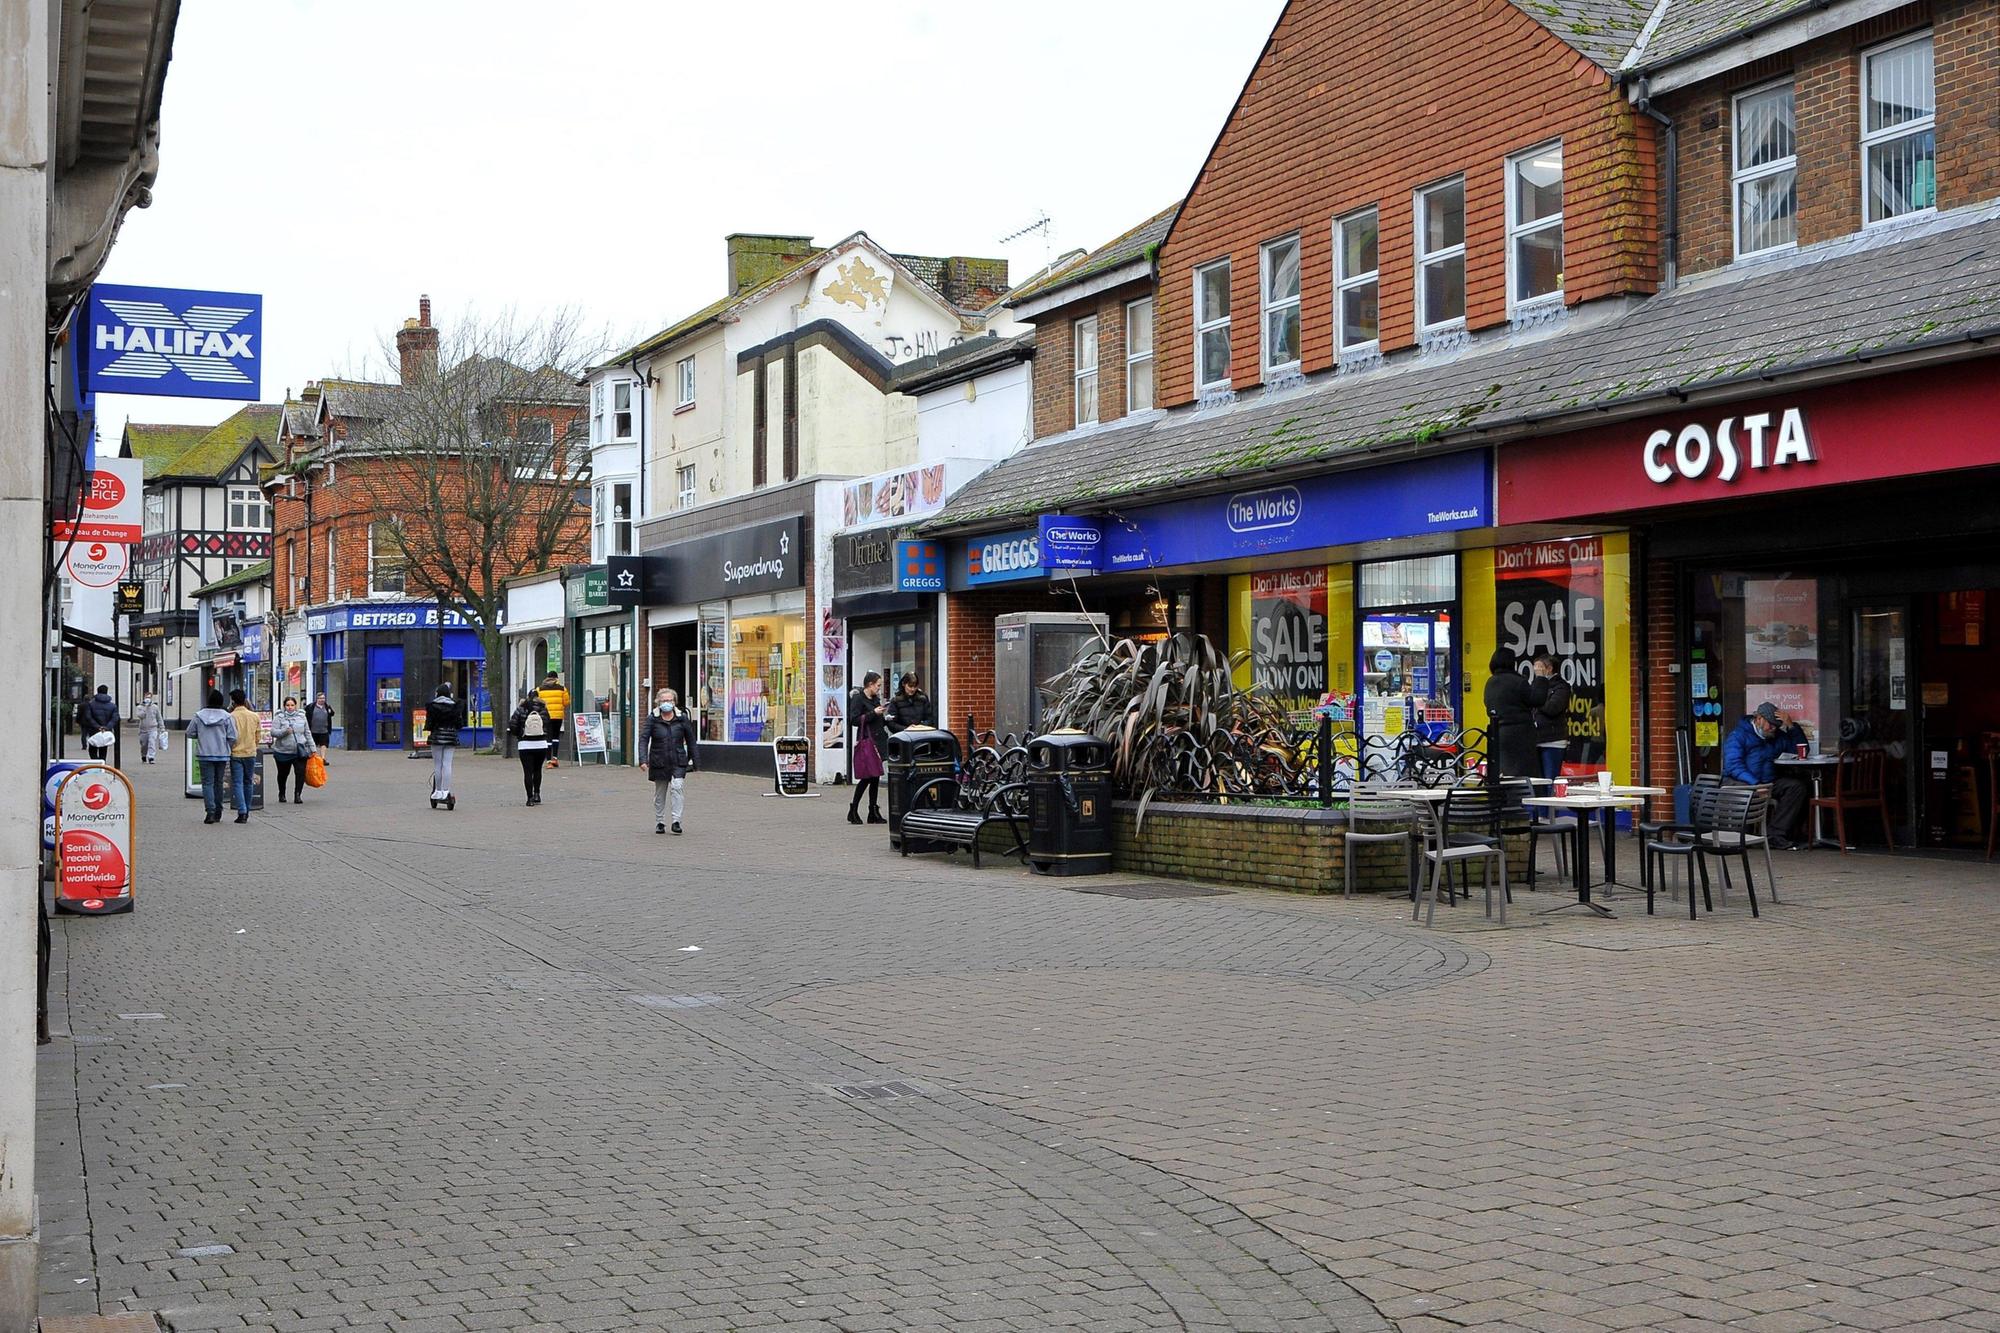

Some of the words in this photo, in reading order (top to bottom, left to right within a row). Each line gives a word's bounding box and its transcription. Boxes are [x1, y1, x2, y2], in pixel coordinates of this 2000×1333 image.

[96, 325, 254, 358] HALIFAX
[1643, 407, 1812, 483] COSTA
[91, 479, 114, 489] OST
[1232, 502, 1253, 523] The
[1256, 495, 1296, 520] Works
[1428, 506, 1478, 523] TheWorks.co.uk
[103, 529, 128, 538] Change
[1051, 531, 1066, 540] The
[1069, 531, 1097, 541] Works
[983, 539, 1039, 573] GREGGS
[1111, 552, 1145, 564] TheWorks.co.uk
[1498, 547, 1533, 568] Don't
[1536, 545, 1565, 564] Miss
[1569, 542, 1598, 561] Out!
[73, 562, 120, 570] MoneyGram
[724, 556, 784, 584] Superdrug
[903, 578, 941, 587] GREGGS
[1254, 575, 1278, 592] Don't
[1280, 572, 1301, 590] Miss
[1303, 570, 1325, 587] Out!
[352, 612, 416, 626] BETFRED
[1503, 597, 1596, 658] SALE
[1255, 615, 1323, 665] SALE
[1255, 666, 1292, 690] NOW
[1296, 665, 1323, 690] ON!
[1560, 658, 1597, 687] ON!
[1782, 692, 1803, 702] your
[1781, 701, 1804, 710] lunch
[1567, 715, 1601, 737] tock!
[67, 812, 125, 822] MoneyGram
[66, 844, 91, 852] Send
[92, 843, 111, 851] and
[66, 864, 100, 873] money
[66, 873, 116, 882] worldwide
